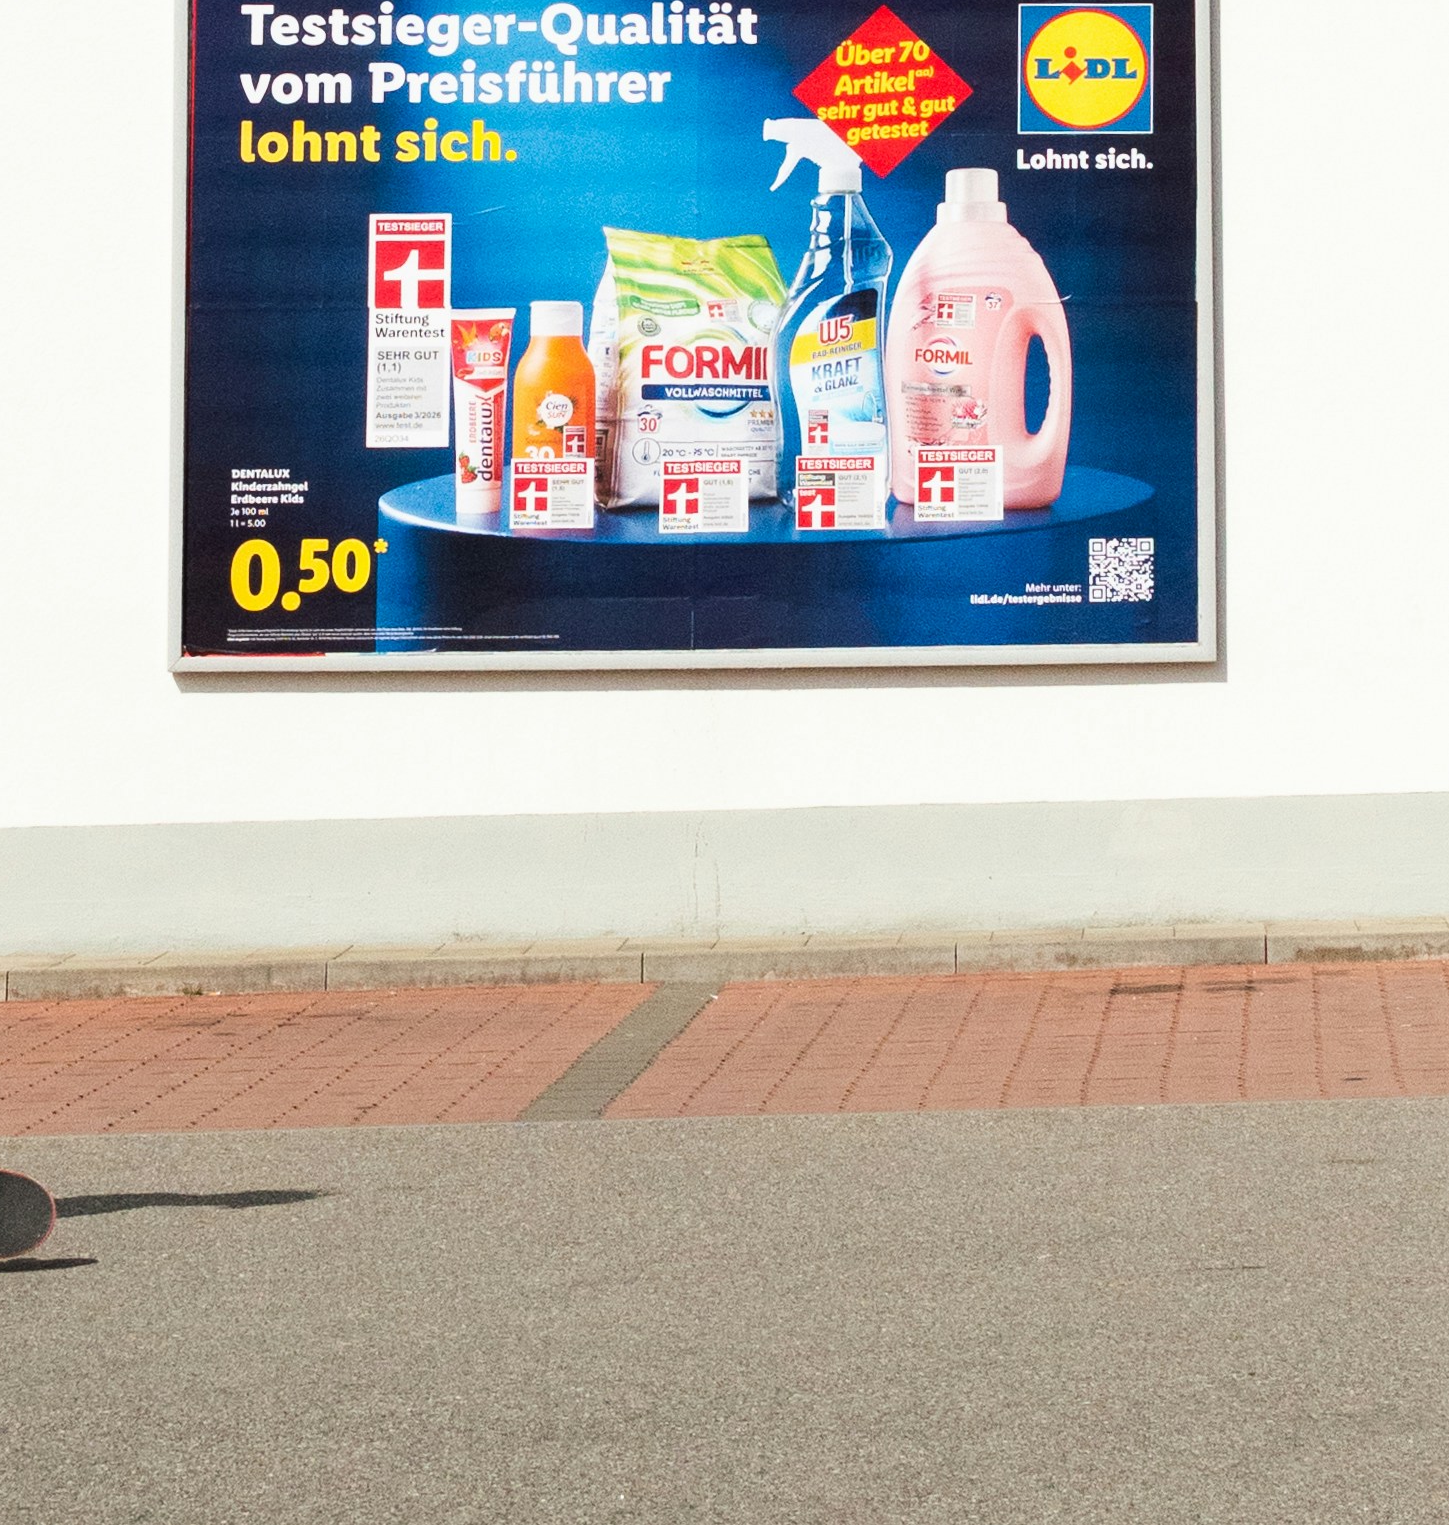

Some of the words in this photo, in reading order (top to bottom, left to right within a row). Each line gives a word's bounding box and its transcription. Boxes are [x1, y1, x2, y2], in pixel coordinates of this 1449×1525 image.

[241, 1, 758, 56] Testsieger-Qualität
[836, 40, 895, 66] Über
[899, 40, 930, 62] 70
[239, 72, 352, 104] vom
[368, 59, 671, 104] Preisführer
[817, 101, 860, 121] sehr
[863, 99, 898, 122] gut
[902, 97, 917, 116] &
[920, 96, 955, 118] gut
[240, 119, 380, 162] lohnt
[395, 117, 518, 162] sich.
[847, 121, 929, 146] getestet
[1017, 148, 1089, 169] Lohnt
[1095, 147, 1153, 169] sich.
[378, 222, 444, 232] TESTSIEGER
[375, 313, 429, 326] Stiftung
[375, 327, 445, 338] Warentest
[377, 350, 410, 360] SEHR
[414, 350, 439, 360] GUT
[467, 351, 502, 363] KIDS
[915, 348, 973, 365] FORMIL
[812, 356, 862, 380] KRAFT
[825, 376, 859, 391] GLANZ
[665, 387, 763, 398] VOLLWASCHMITTEL
[545, 401, 568, 411] Cien
[376, 412, 413, 420] Ausgabe
[639, 417, 657, 432] 30
[475, 394, 493, 481] dentalux
[921, 451, 993, 461] TESTSIEGER
[517, 463, 585, 473] TESTSIEGER
[666, 462, 739, 473] TESTSIEGER
[800, 459, 872, 470] TESTSIEGER
[231, 469, 290, 479] DENTALUX
[231, 481, 308, 493] Kinderzahngel
[231, 494, 278, 504] Erdbeere
[280, 494, 304, 504] Kids
[230, 507, 240, 516] Je
[241, 507, 256, 516] 100
[258, 507, 268, 516] ml
[247, 519, 266, 527] 5.00
[1025, 583, 1050, 592] Mehr
[1052, 584, 1082, 592] unter:
[970, 593, 1082, 605] lidl.de/testergebnisse
